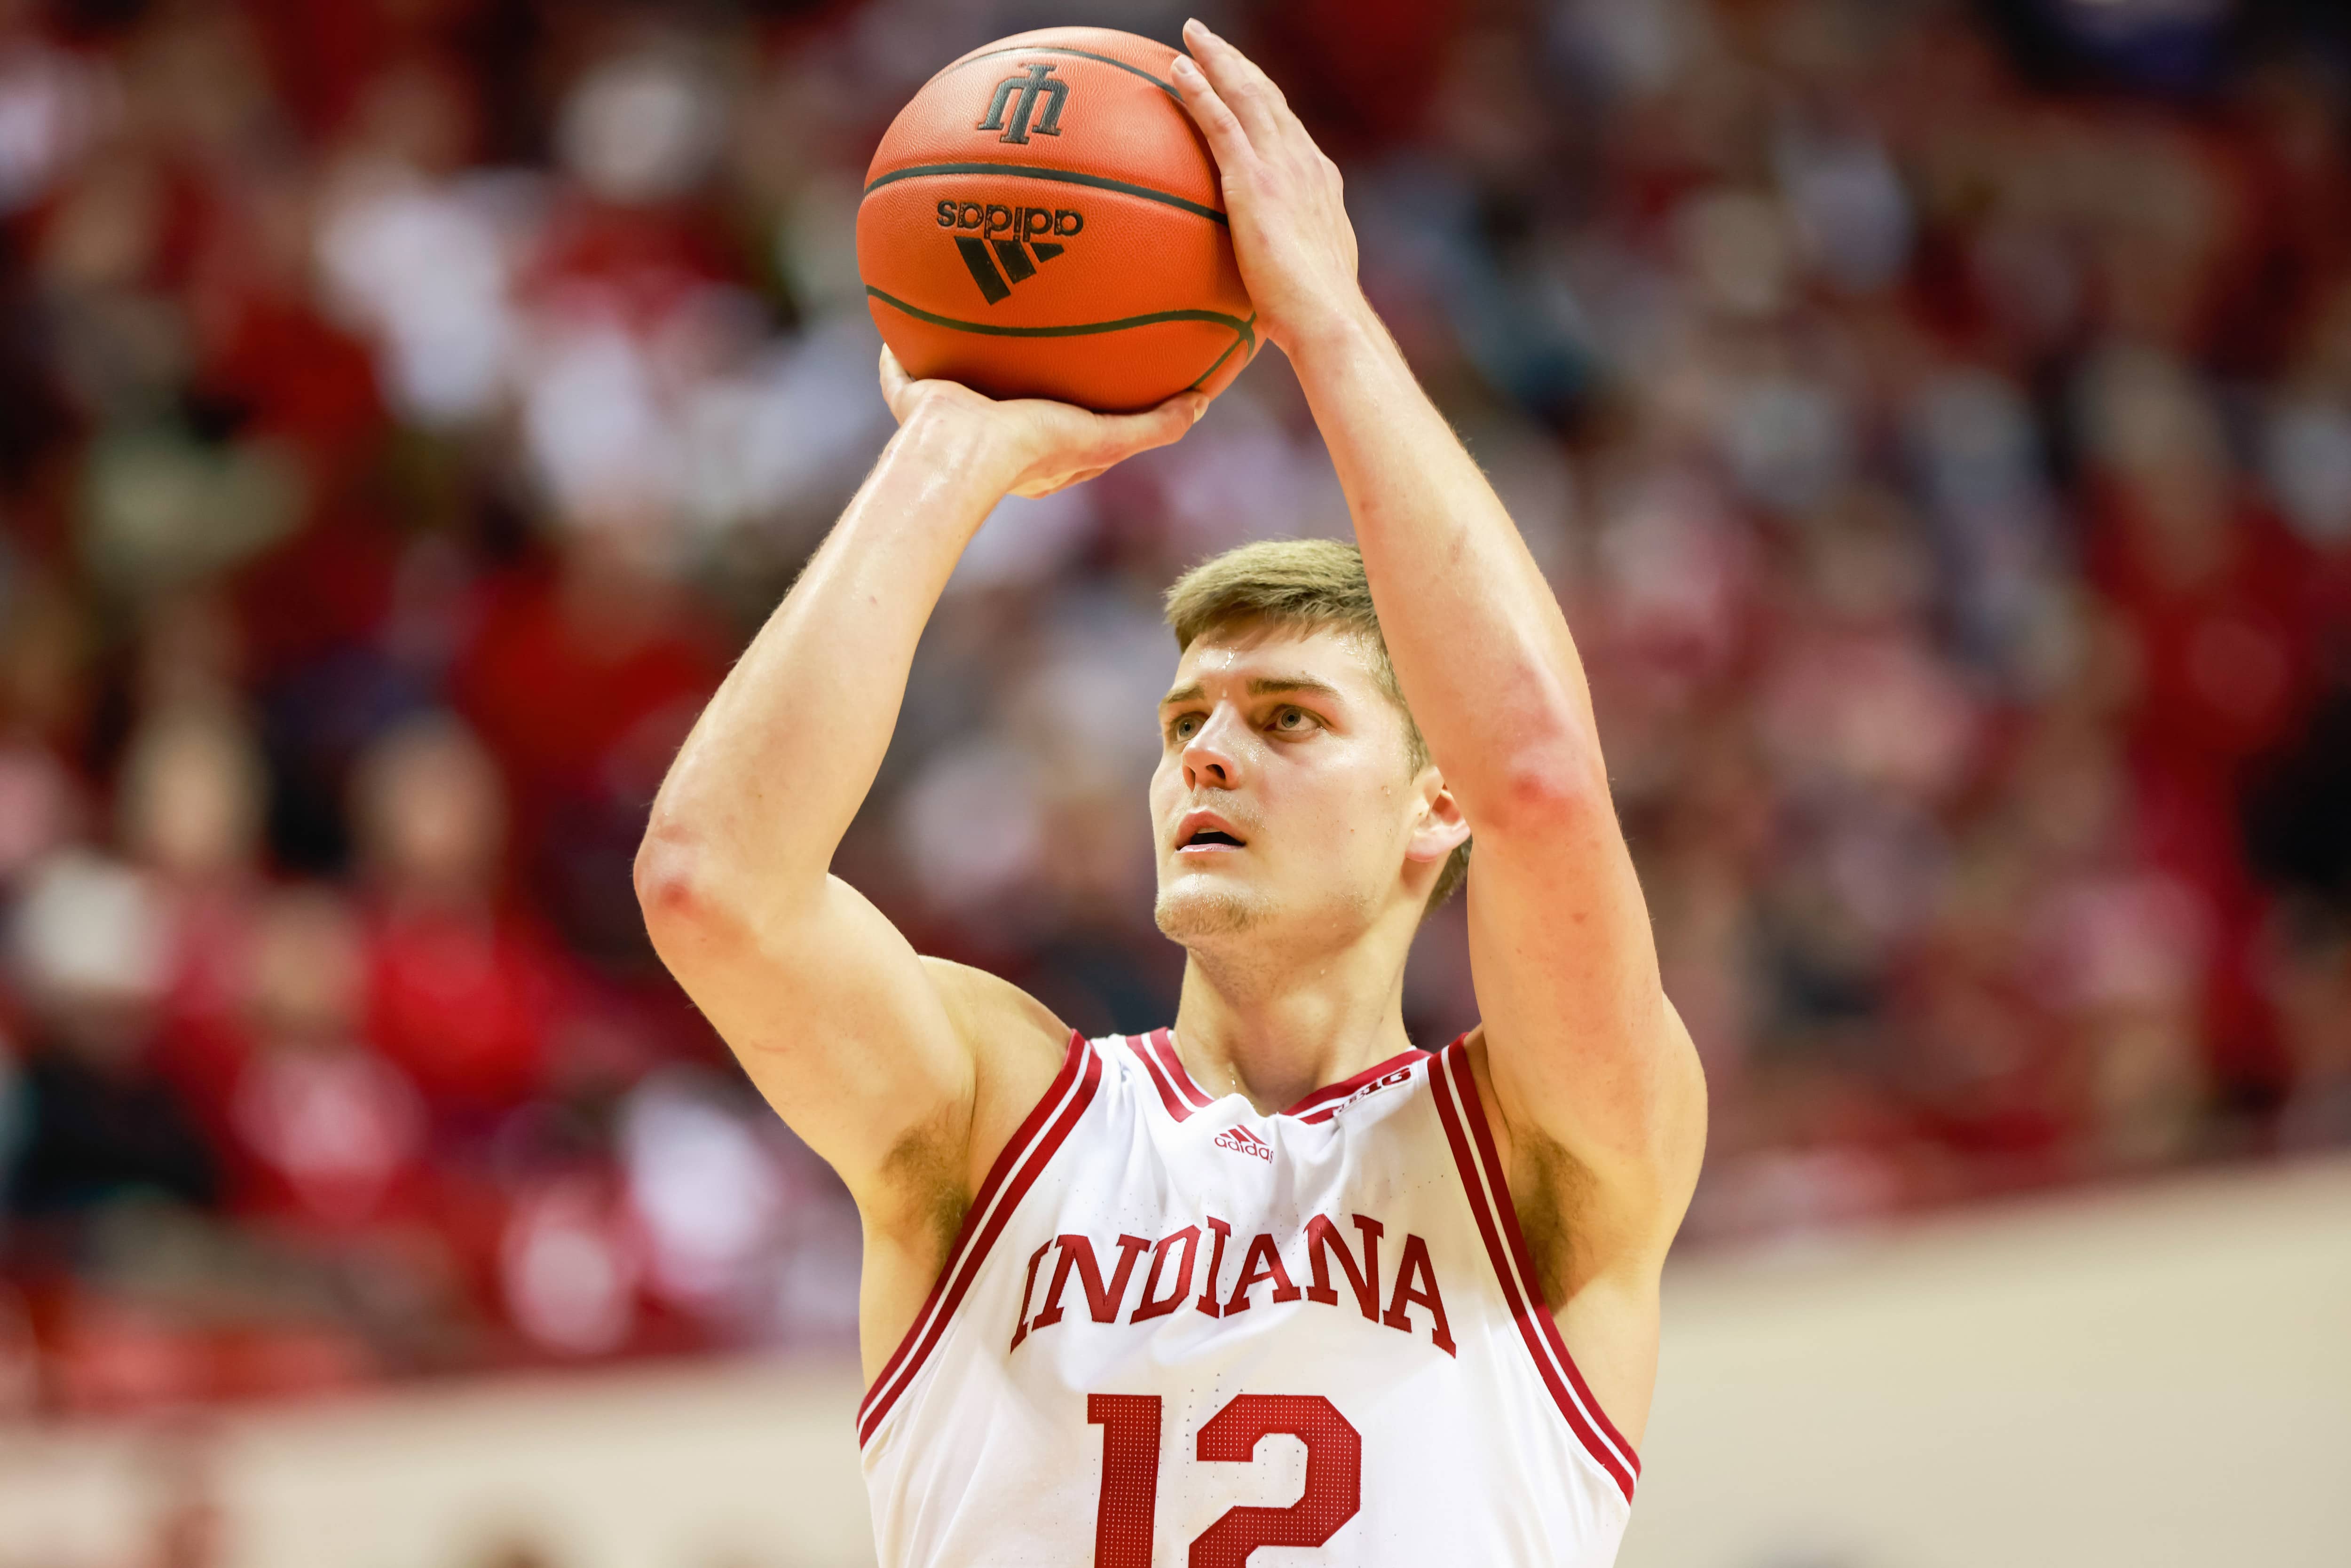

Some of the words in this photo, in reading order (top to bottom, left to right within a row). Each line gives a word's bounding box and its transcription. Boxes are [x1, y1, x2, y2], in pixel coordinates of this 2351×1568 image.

[937, 200, 1084, 243] adidas
[1215, 1137, 1274, 1164] adidas
[1010, 1213, 1456, 1359] INDIANA
[1087, 1393, 1362, 1568] 12
